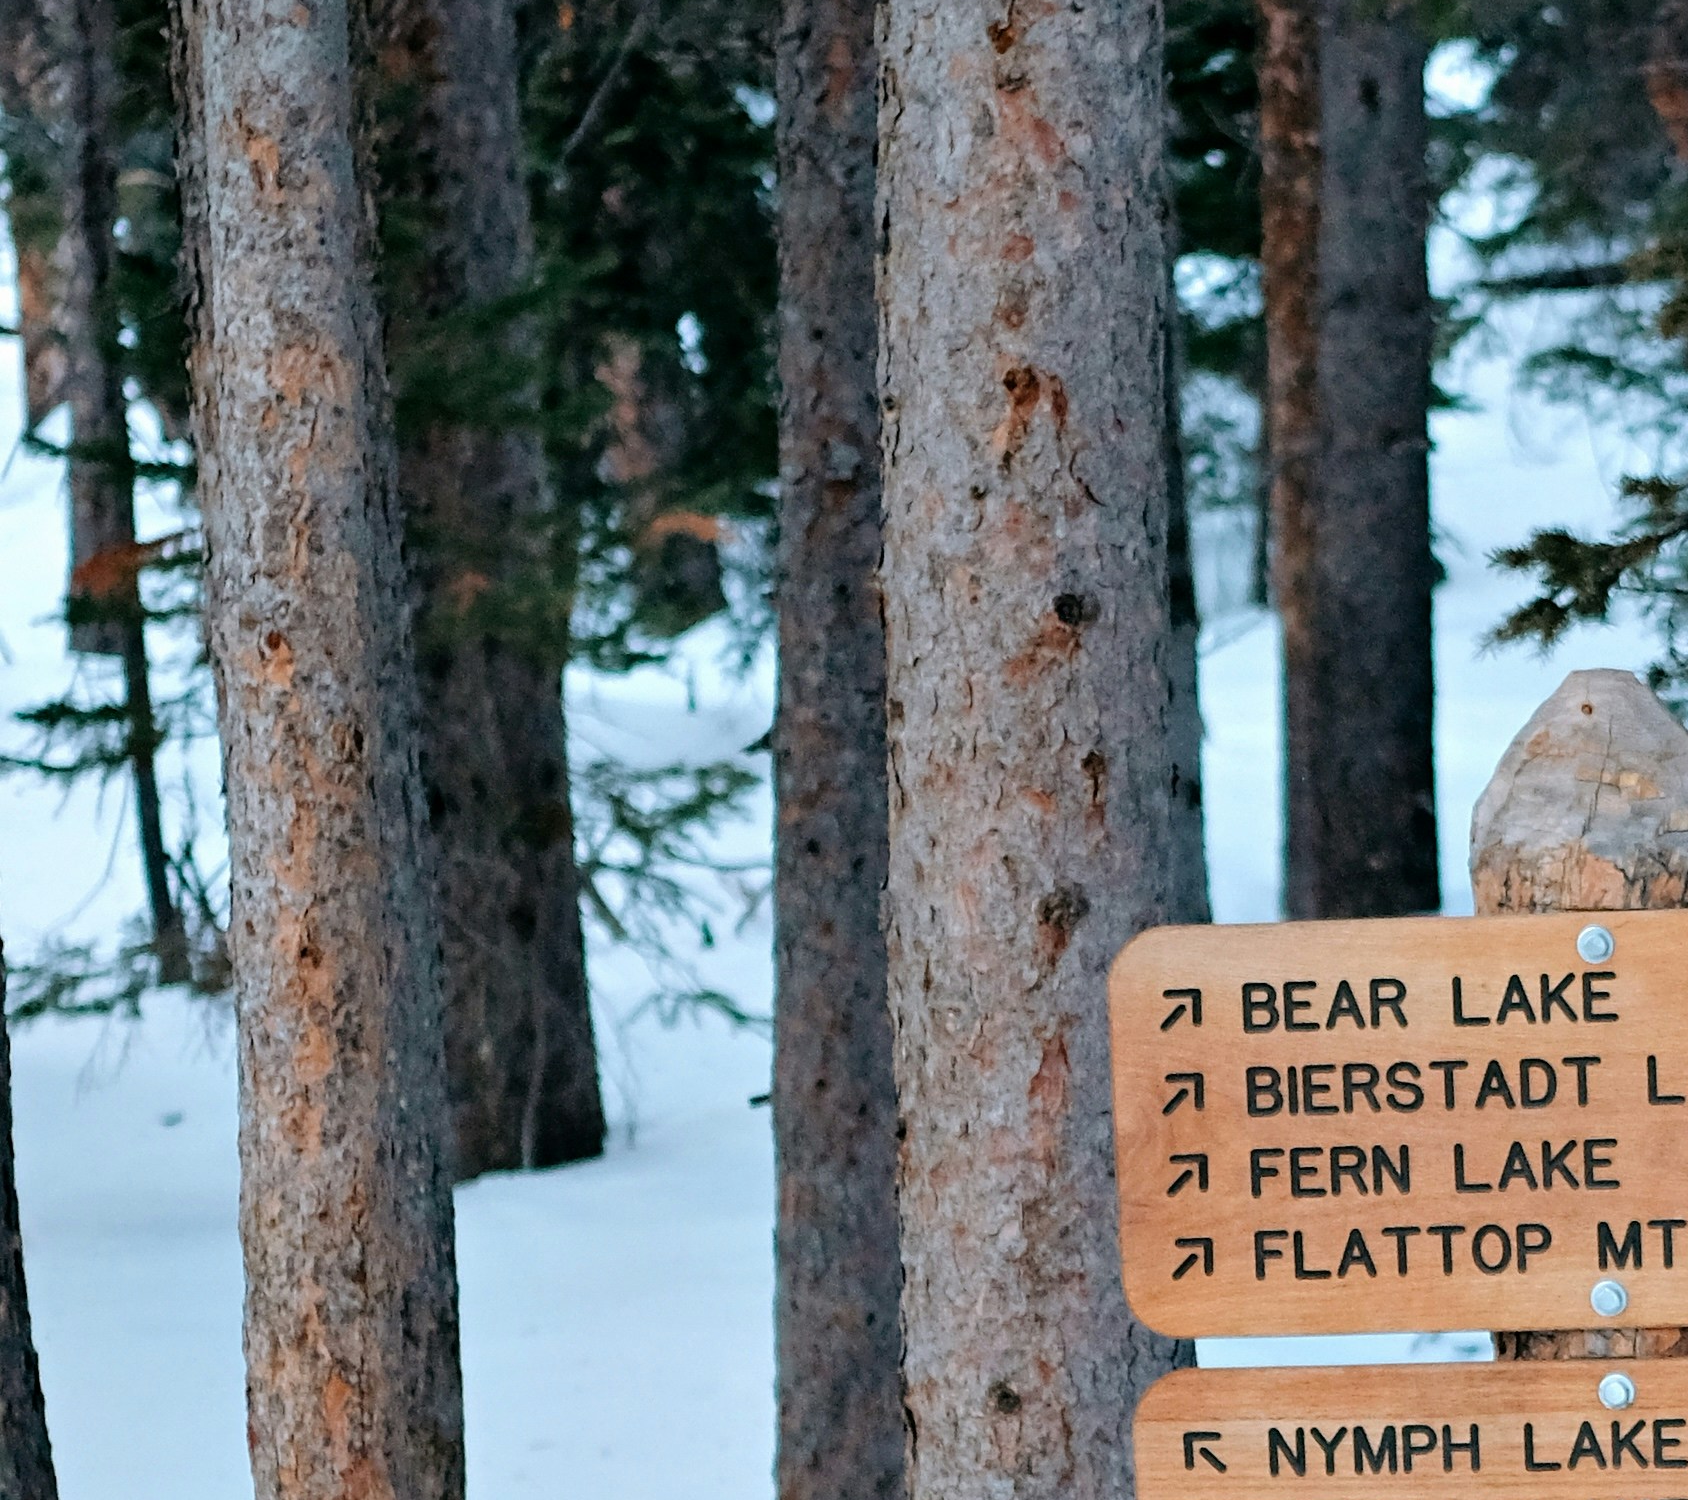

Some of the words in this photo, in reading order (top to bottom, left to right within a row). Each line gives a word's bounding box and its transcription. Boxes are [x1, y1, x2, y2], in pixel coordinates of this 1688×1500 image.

[1241, 979, 1409, 1034] BEAR
[1451, 972, 1620, 1027] LAKE
[1245, 1055, 1602, 1118] BIERSTADT
[1249, 1144, 1411, 1199] FERN
[1453, 1138, 1621, 1193] LAKE
[1253, 1223, 1553, 1281] FLATTOP
[1268, 1423, 1481, 1477] NYMPH
